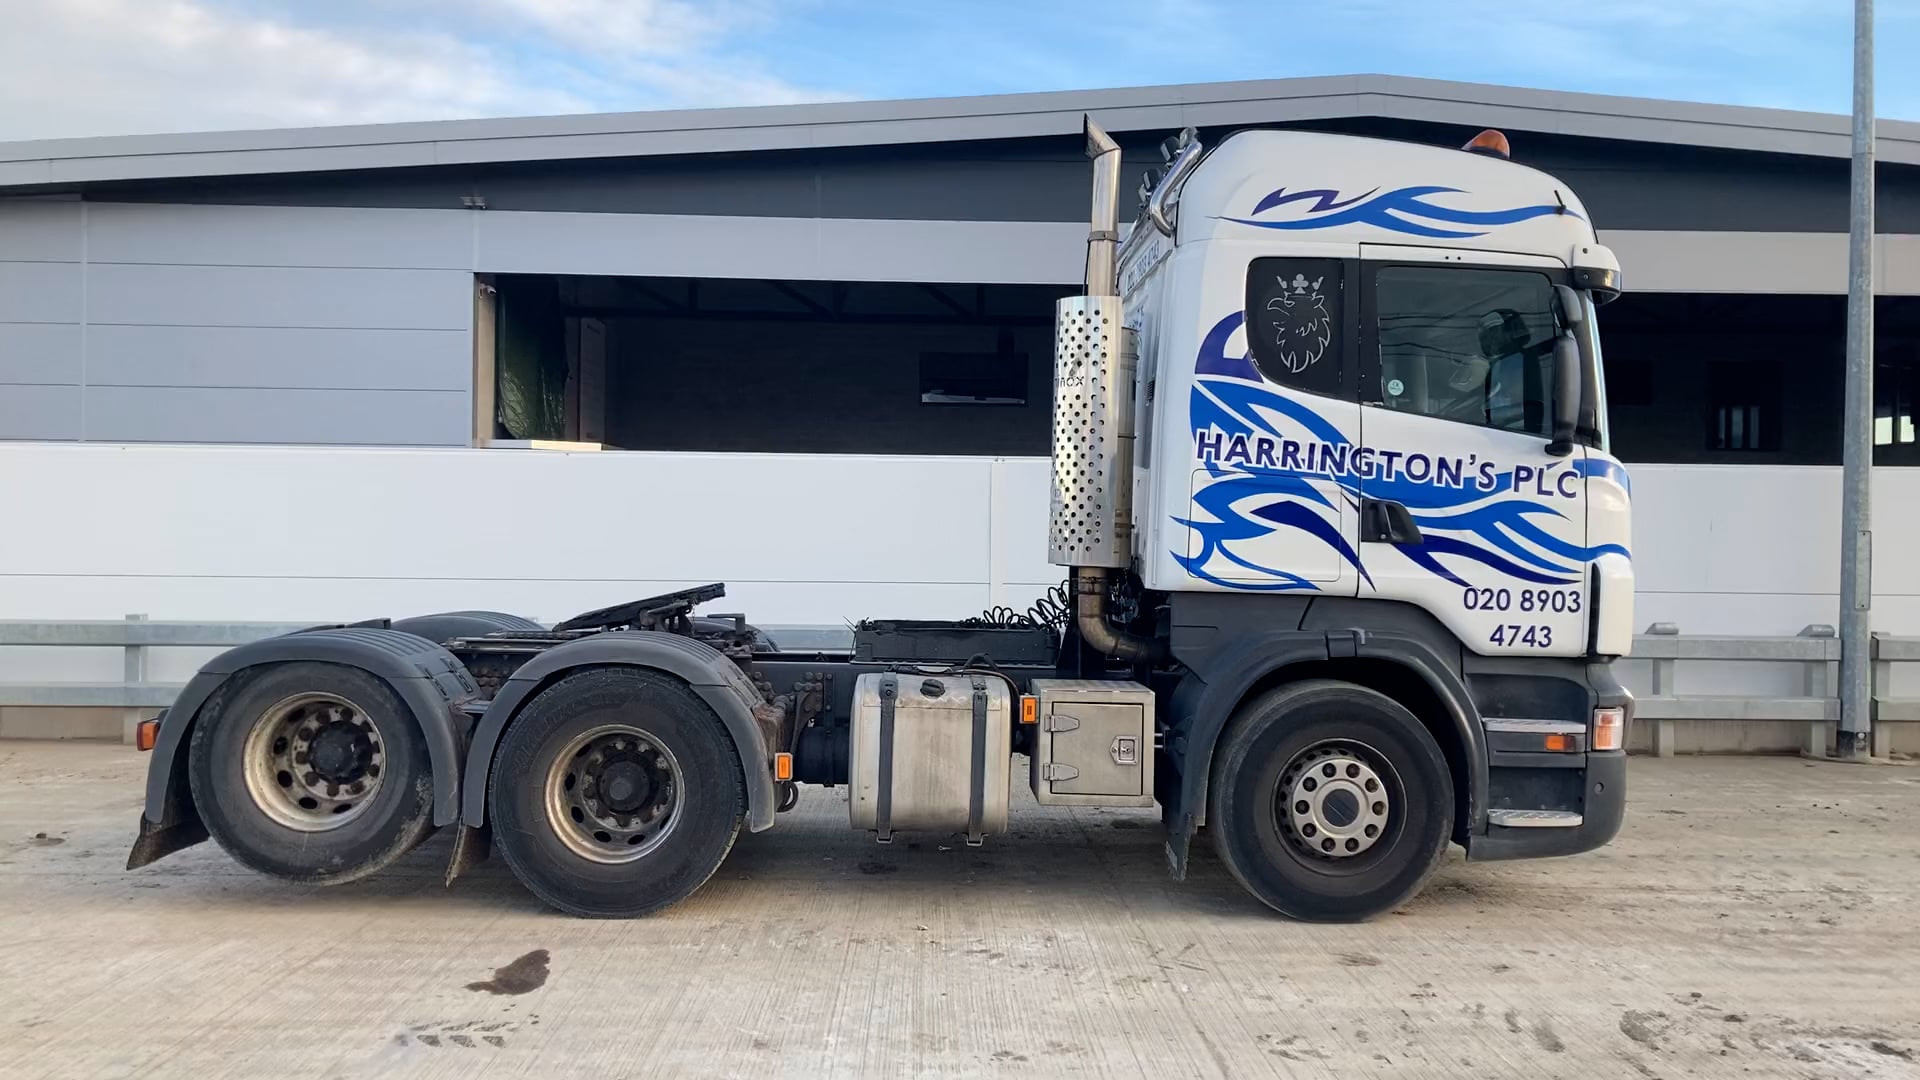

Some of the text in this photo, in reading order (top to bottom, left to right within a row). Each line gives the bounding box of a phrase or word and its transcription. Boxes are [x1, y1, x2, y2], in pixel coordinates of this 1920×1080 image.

[1195, 430, 1579, 499] HARRINGTON'S PLC
[1463, 587, 1582, 614] 020 8903
[1489, 623, 1553, 648] 4743
